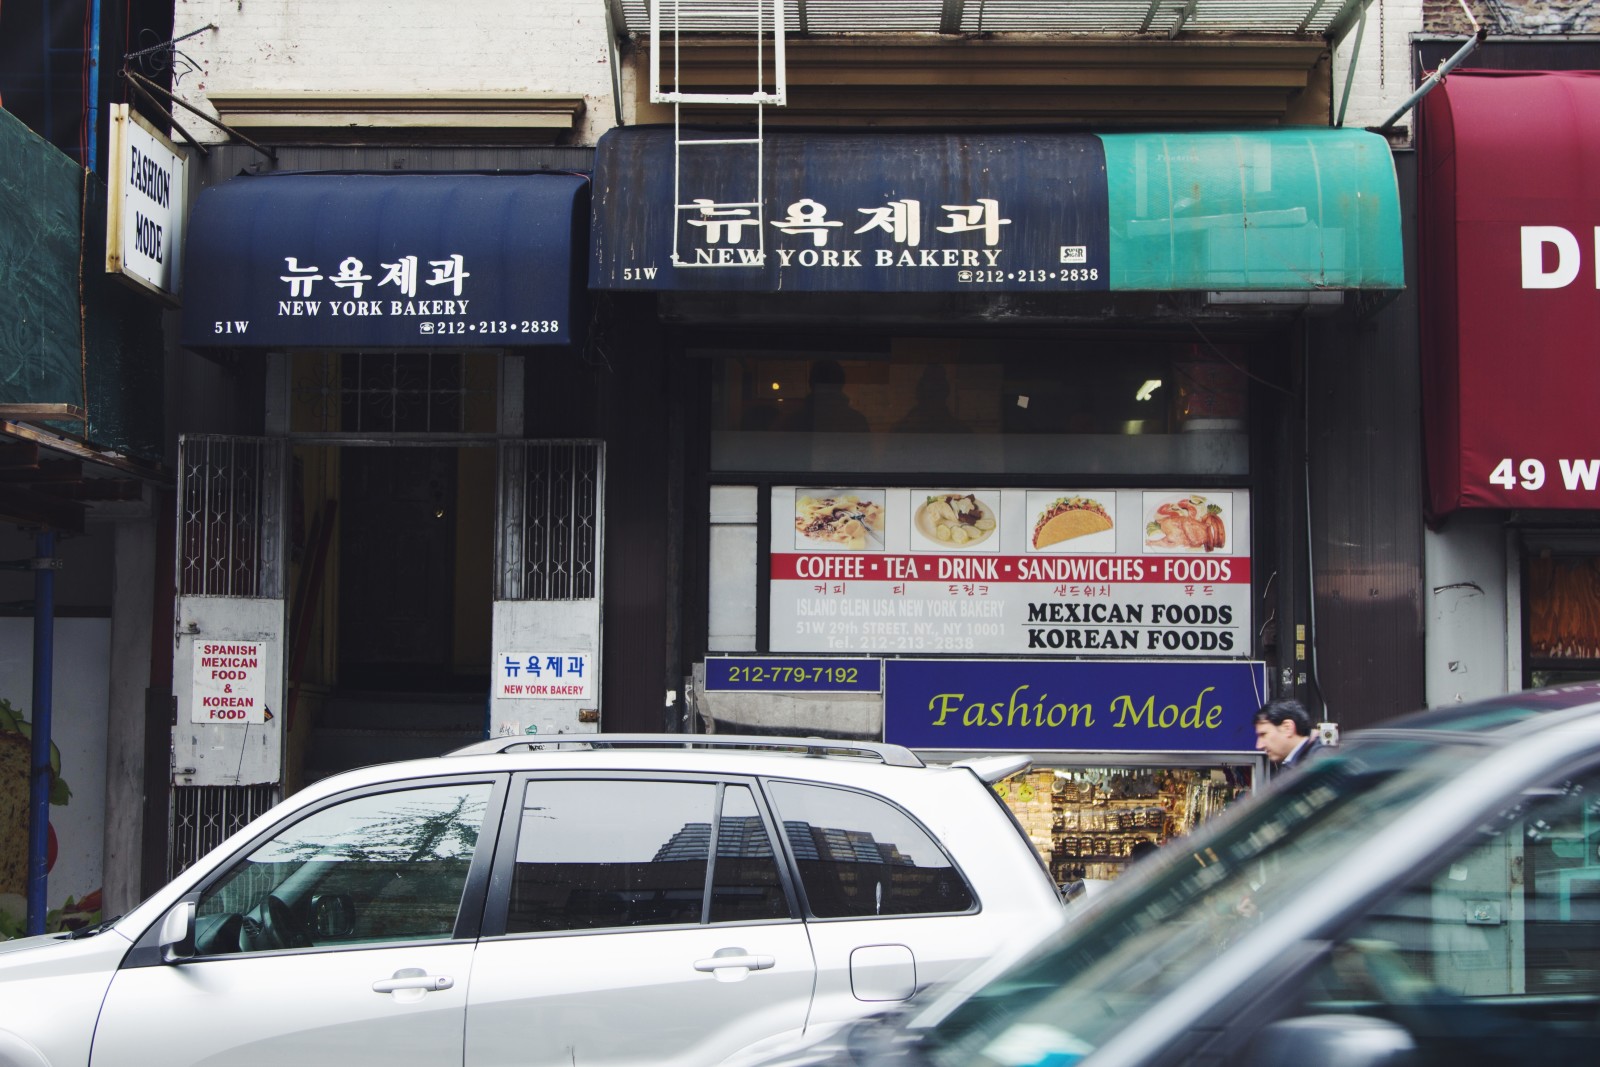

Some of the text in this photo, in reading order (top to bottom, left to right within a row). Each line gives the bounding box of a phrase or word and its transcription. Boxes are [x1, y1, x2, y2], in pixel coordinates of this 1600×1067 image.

[131, 145, 170, 210] FASHION
[687, 198, 1012, 246] 뉴욕제과
[135, 210, 162, 264] MODE
[694, 248, 1003, 267] NEW YORK BAKERY
[1520, 226, 1600, 289] D
[279, 255, 470, 298] 뉴욕제과
[623, 267, 658, 281] 51W
[278, 300, 470, 316] NEW YORK BAKERY
[214, 320, 249, 334] 51W
[1489, 458, 1546, 490] 49
[796, 556, 1232, 582] COFFEE TEA DRINK SANDWICHES FOODS
[814, 582, 846, 596] 커피
[893, 582, 905, 596] 티
[948, 584, 989, 597] 드링크
[1184, 584, 1214, 597] 푸드
[796, 598, 1005, 618] ISLAND GLEN USA NEW YORK BAKERY
[1027, 602, 1233, 625] MEXICAN FOODS
[796, 621, 825, 635] 51W
[829, 621, 858, 635] 29th
[943, 623, 964, 636] NY
[967, 623, 1005, 636] 10001
[827, 636, 974, 649] Tel. 212-213-2838
[1027, 628, 1234, 651] KOREAN FOODS
[204, 644, 257, 655] SPANISH
[201, 658, 258, 668] MEXICAN
[504, 655, 585, 678] 뉴욕제과
[212, 670, 247, 680] FOOD
[728, 666, 858, 684] 212-779-7192
[224, 683, 232, 694] &
[504, 685, 584, 695] NEW YORK BAKERY
[203, 697, 254, 707] KOREAN
[928, 684, 1224, 730] Fashion Mode
[209, 709, 246, 720] FOOD
